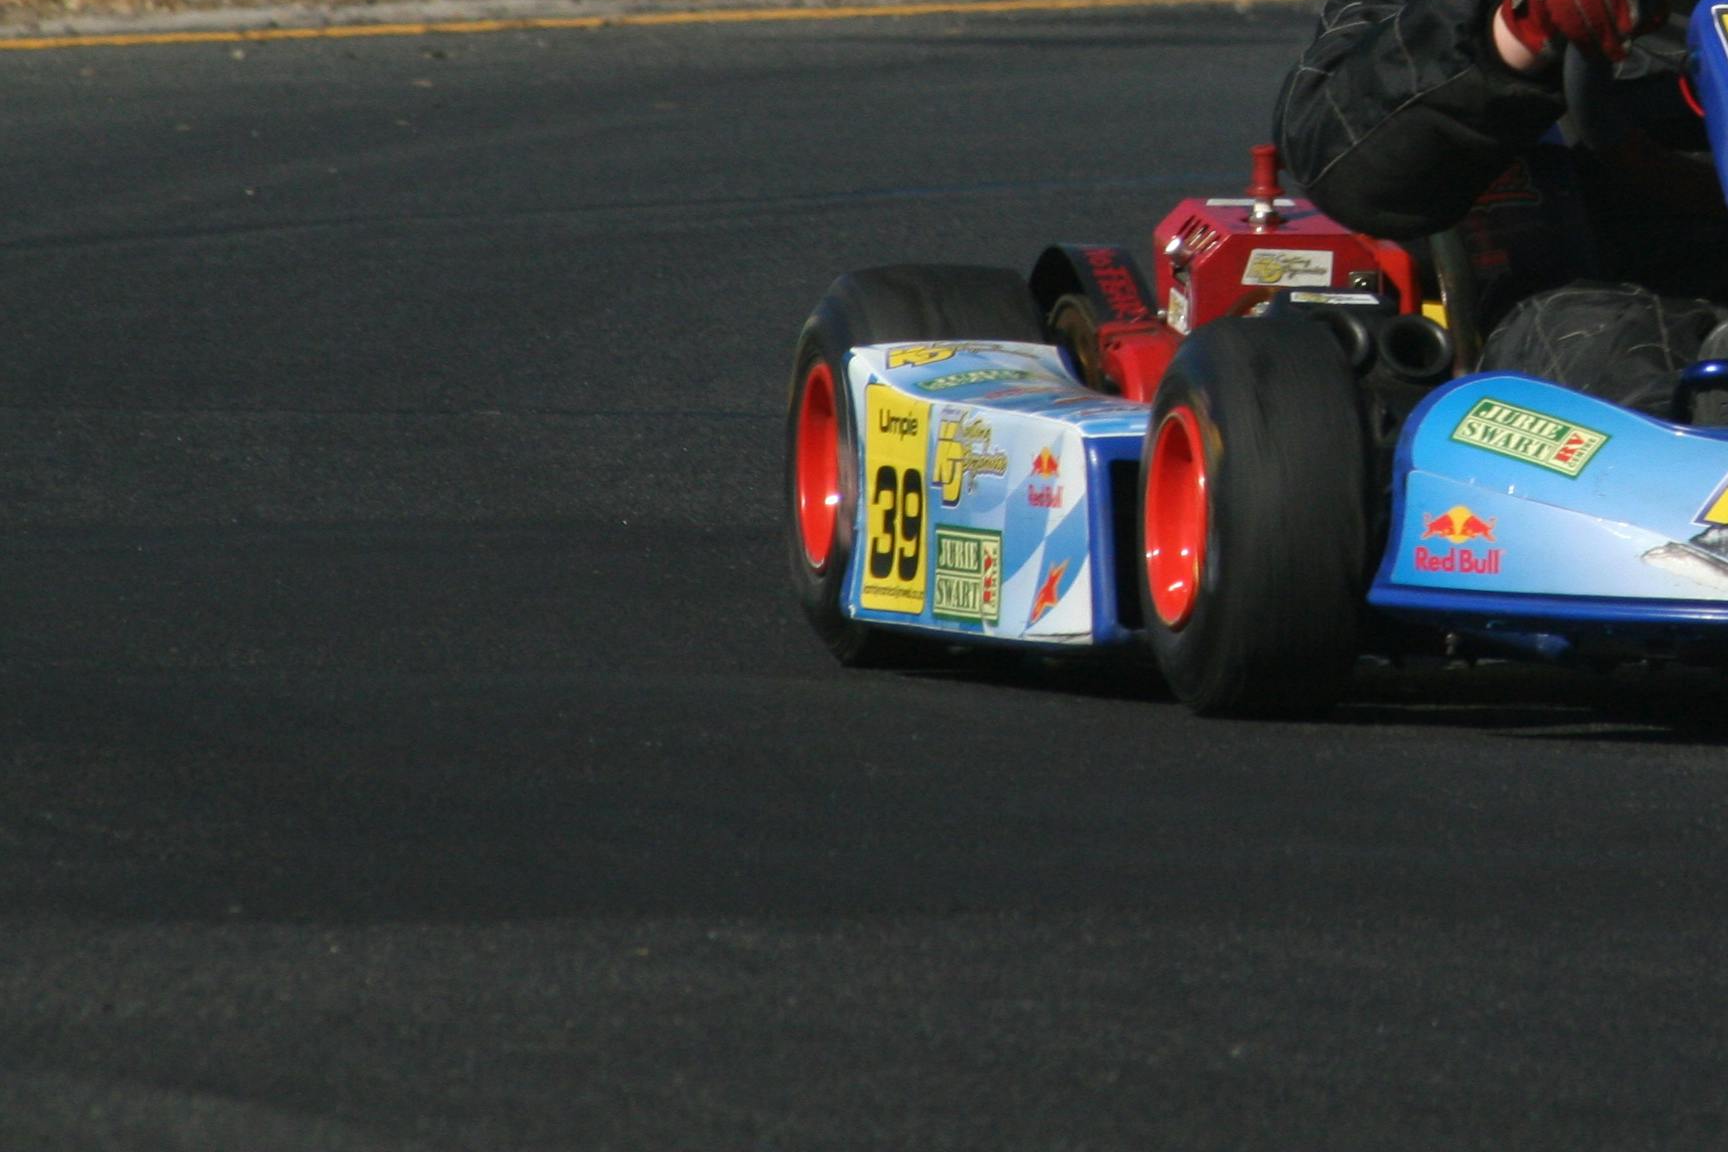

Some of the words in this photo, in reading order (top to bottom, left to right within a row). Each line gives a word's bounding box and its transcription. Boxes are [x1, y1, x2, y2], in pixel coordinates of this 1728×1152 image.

[879, 408, 918, 442] Umpie
[1480, 405, 1564, 440] JURIE
[1463, 421, 1550, 460] SWART
[869, 465, 923, 581] 39
[940, 538, 978, 570] JURIE
[1414, 545, 1456, 572] Red
[1459, 548, 1500, 575] Bull
[936, 577, 980, 610] SWART
